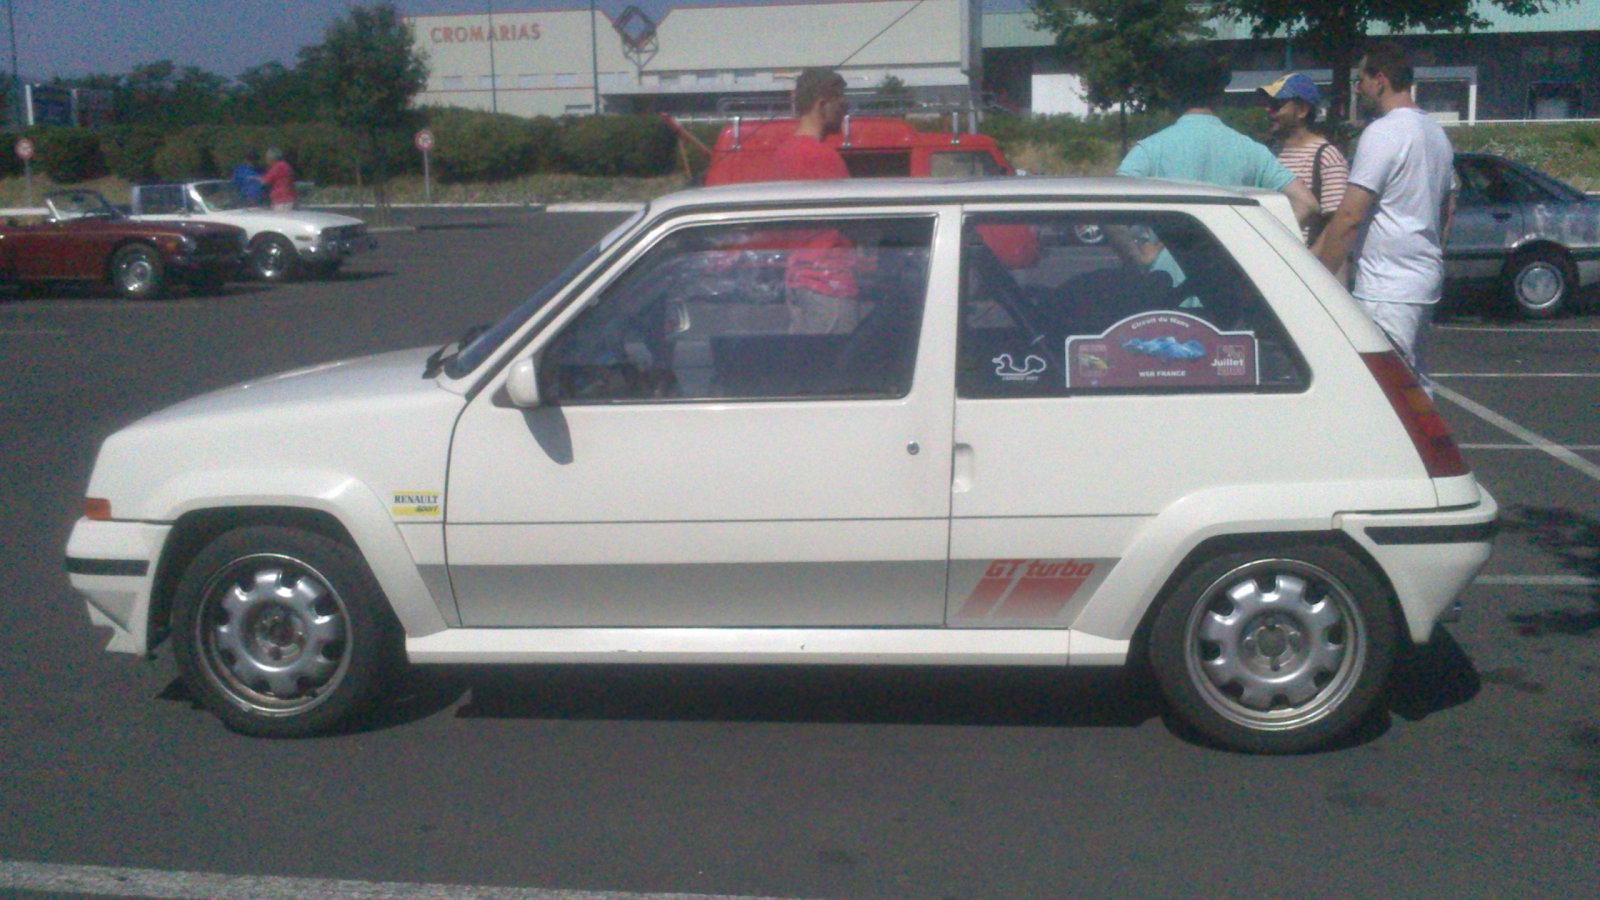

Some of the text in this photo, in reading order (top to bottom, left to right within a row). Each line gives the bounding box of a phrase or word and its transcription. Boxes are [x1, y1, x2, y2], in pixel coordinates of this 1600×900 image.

[430, 23, 541, 43] CROMARIAS
[1211, 358, 1244, 367] Juillet
[1156, 370, 1187, 378] FRANCE
[394, 495, 438, 504] RENAULT
[985, 558, 1096, 577] GT turbo
